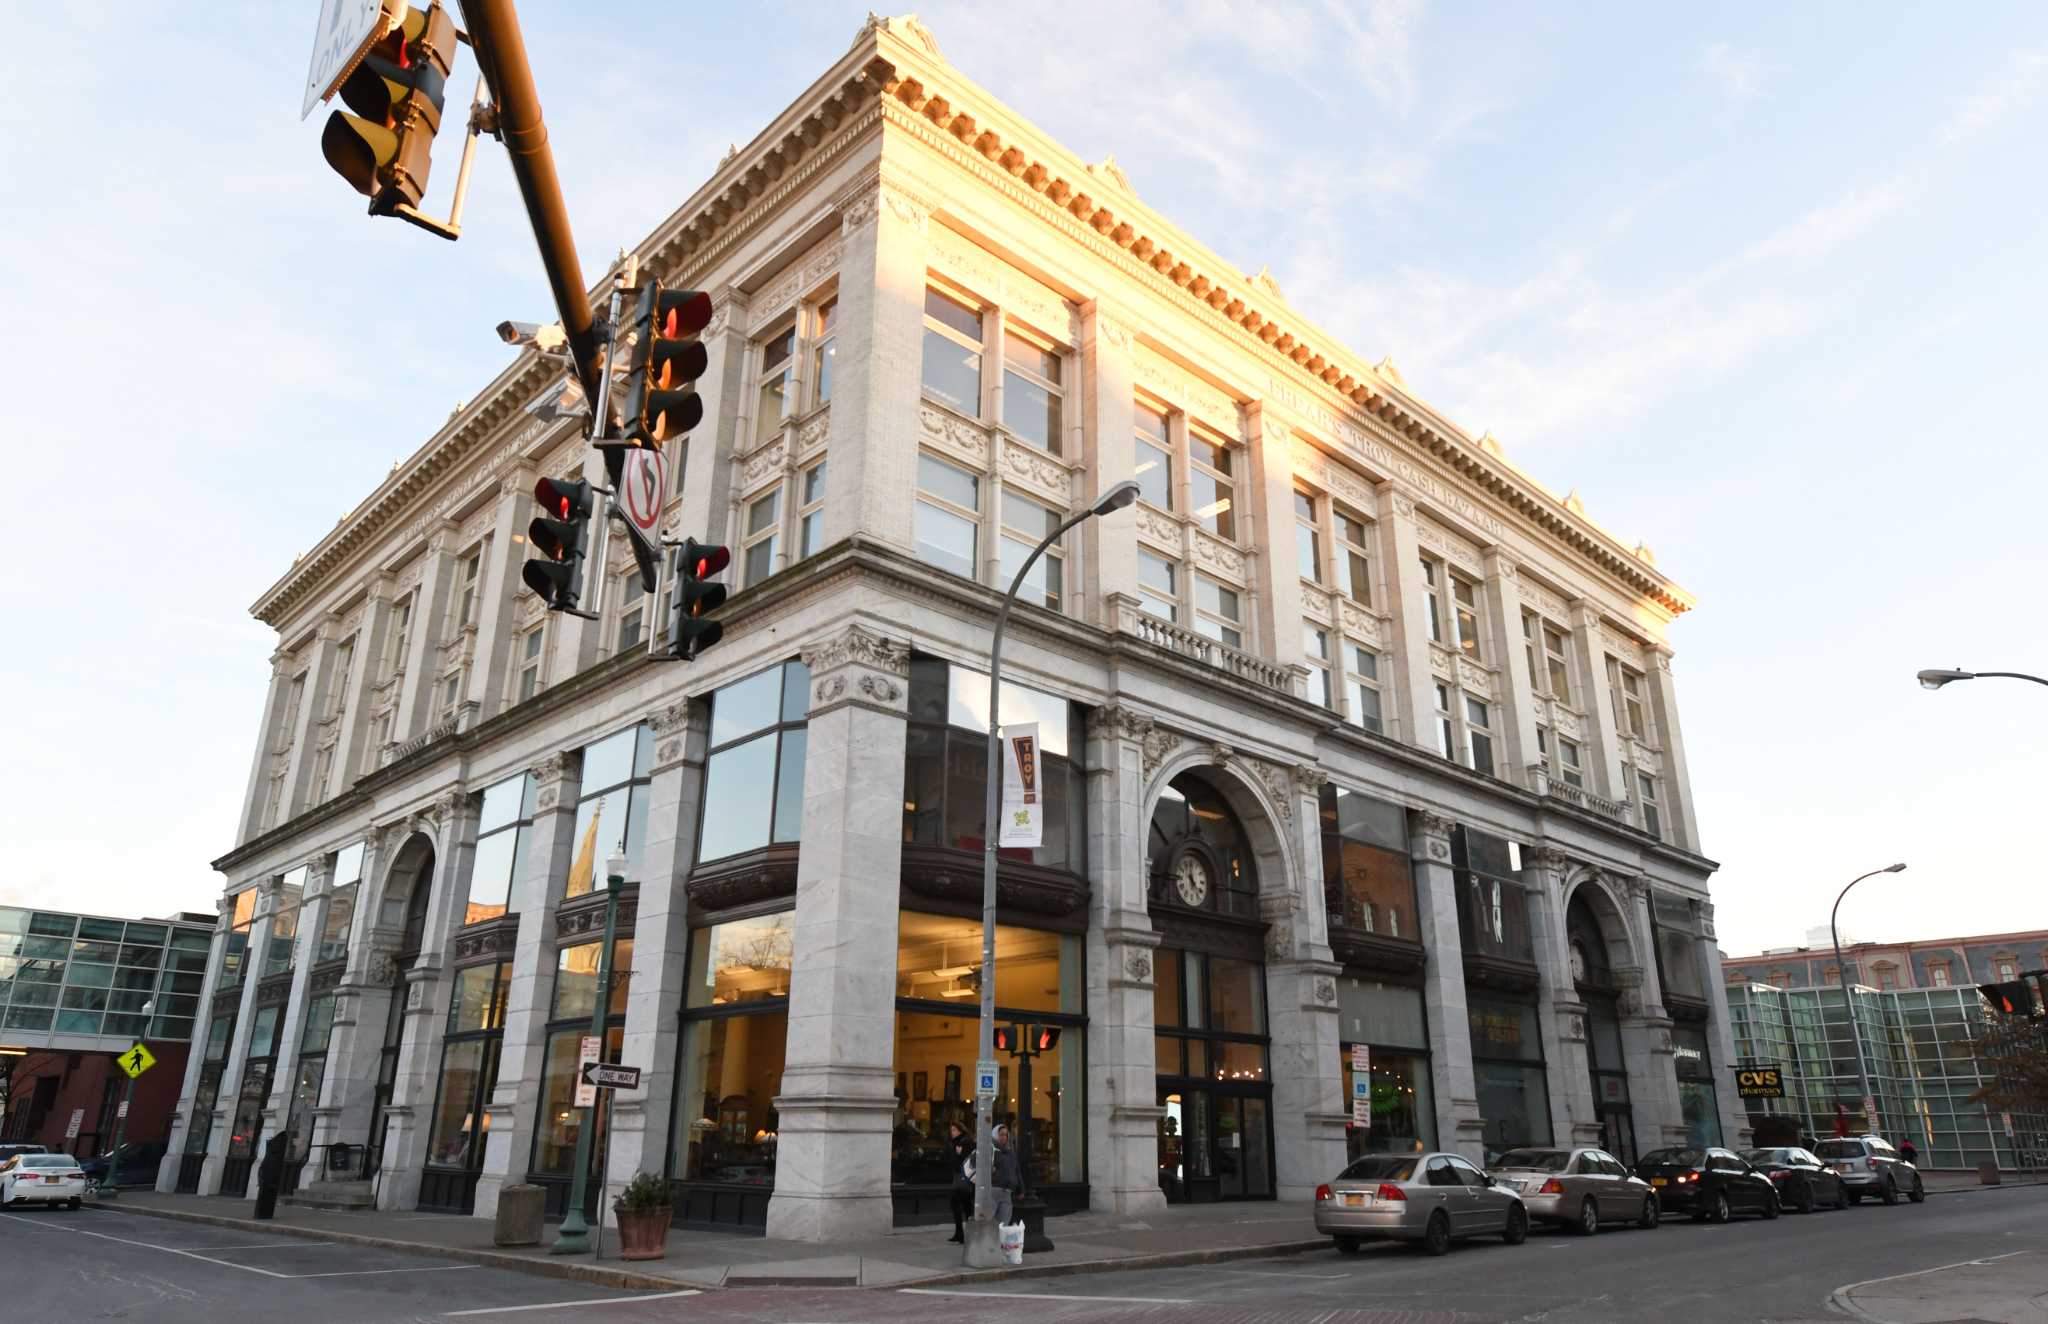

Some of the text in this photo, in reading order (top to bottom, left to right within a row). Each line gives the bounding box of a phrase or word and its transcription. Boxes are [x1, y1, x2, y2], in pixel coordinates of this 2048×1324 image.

[317, 0, 371, 84] ONLY
[1351, 426, 1393, 468] TROY
[600, 1071, 634, 1083] ONE WAY
[1740, 1071, 1778, 1086] CVS
[1740, 1087, 1782, 1096] pharmacy
